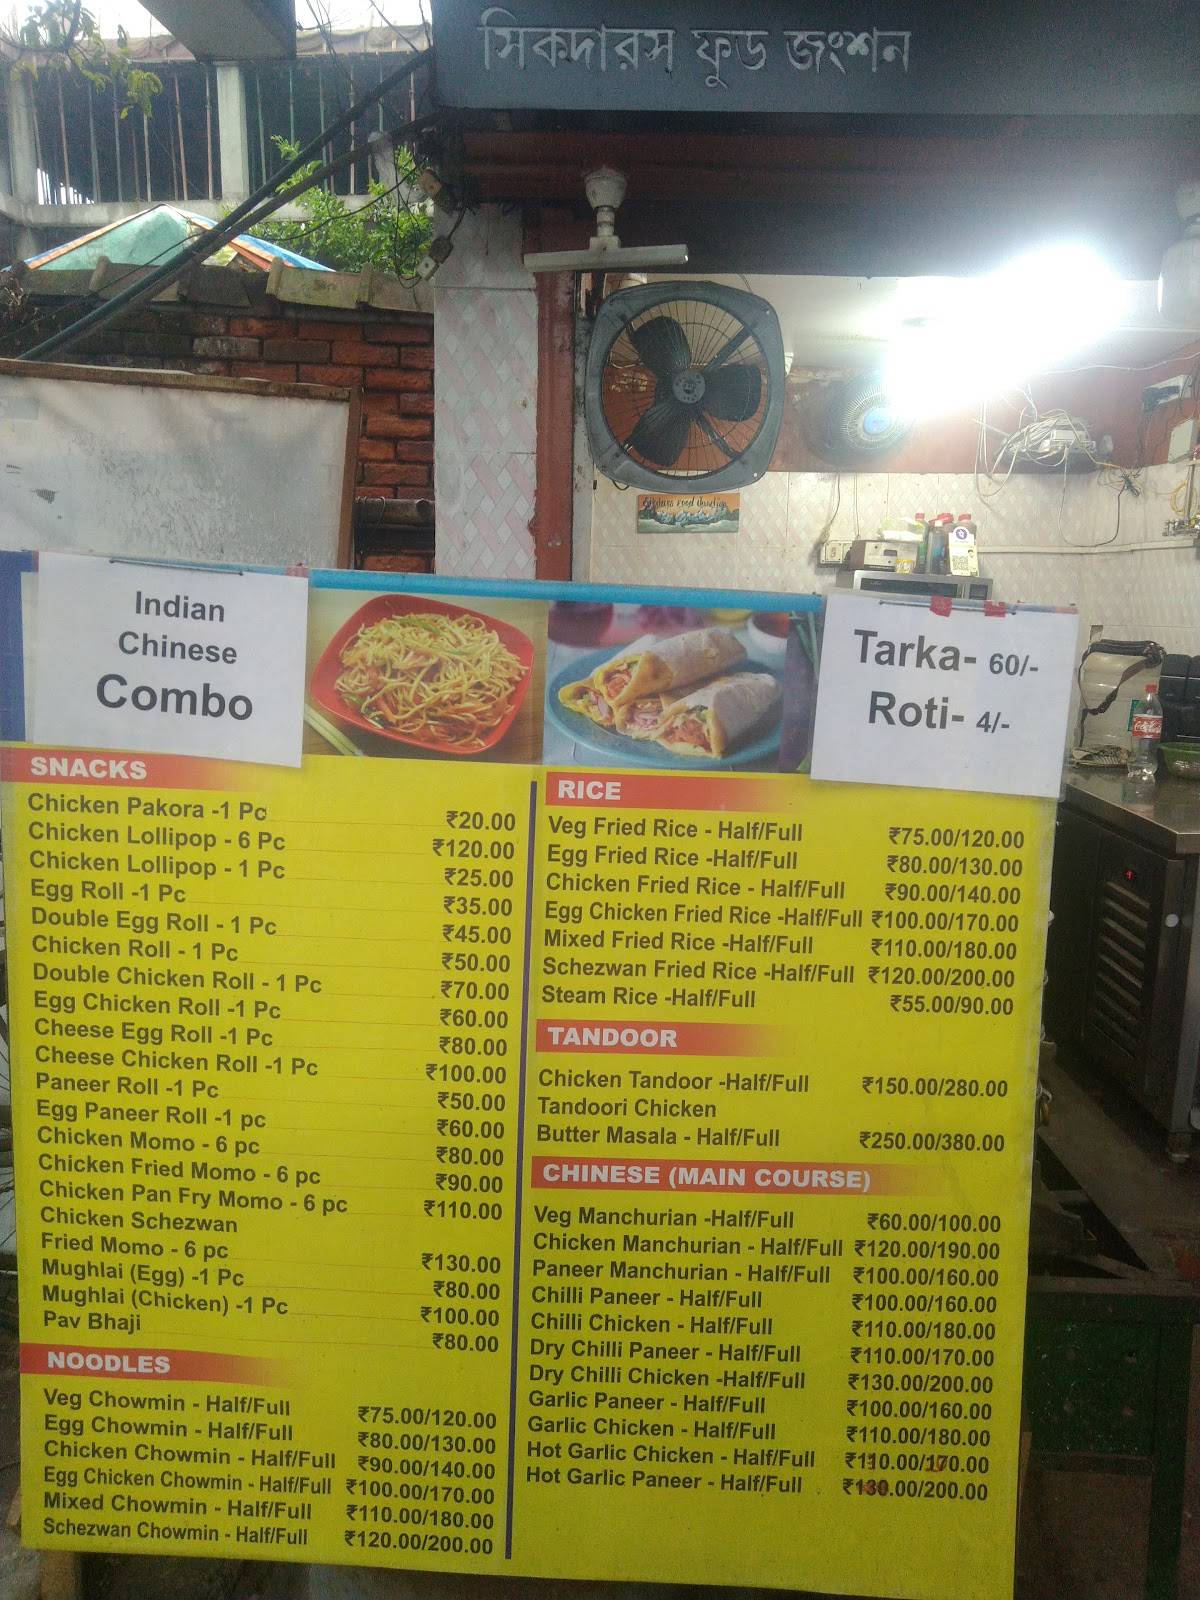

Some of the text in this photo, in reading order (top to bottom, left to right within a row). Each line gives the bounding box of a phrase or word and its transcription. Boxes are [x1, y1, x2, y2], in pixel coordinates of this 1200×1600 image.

[477, 7, 912, 90] সিকদারস ফুড জংশন
[135, 591, 225, 622] Indian
[118, 631, 237, 665] Chinese
[854, 629, 1038, 676] Tarka- 60/-
[96, 673, 253, 721] Combo
[869, 690, 1010, 734] Roti- 4/-
[30, 756, 149, 780] SNACKS
[558, 779, 622, 801] RICE
[28, 792, 119, 815] Chicken
[127, 796, 204, 818] Pakora
[239, 802, 267, 821] Pc
[446, 810, 516, 832] ₹20.00
[547, 843, 588, 868] Egg
[595, 845, 647, 865] Fried
[654, 847, 699, 867] Rice
[886, 854, 1023, 877] ₹80.00/130.00
[31, 878, 73, 903] Egg
[81, 880, 124, 900] Roll
[158, 884, 186, 903] Pc
[443, 895, 513, 917] ₹35.00
[545, 900, 583, 924] Egg
[589, 901, 668, 922] Chicken
[674, 904, 723, 923] Fried
[729, 905, 771, 925] Rice
[871, 910, 1019, 933] ₹100.00/170.00
[544, 928, 605, 948] Mixed
[612, 930, 664, 950] Fried
[671, 932, 716, 951] Rice
[871, 938, 1017, 961] ₹110.00/180.00
[542, 956, 647, 977] Schezwan
[654, 959, 706, 979] Fried
[712, 961, 757, 980] Rice
[868, 966, 1015, 988] ₹120.00/200.00
[34, 990, 76, 1014] Egg
[83, 992, 170, 1014] Chicken
[178, 997, 220, 1016] Roll
[254, 1000, 281, 1019] Pc
[439, 1008, 509, 1029] ₹60.00
[541, 984, 606, 1004] Steam
[613, 986, 658, 1006] Rice
[890, 994, 1014, 1016] ₹55.00/90.00
[34, 1017, 114, 1039] Cheese
[121, 1021, 163, 1046] Egg
[171, 1024, 212, 1044] Roll
[246, 1028, 273, 1047] Pc
[439, 1036, 508, 1057] ₹80.00
[547, 1026, 678, 1048] TANDOOR
[35, 1045, 115, 1066] Cheese
[121, 1049, 208, 1071] Chicken
[216, 1053, 258, 1073] Roll
[291, 1057, 318, 1076] Pc
[425, 1063, 507, 1084] ₹100.00
[36, 1071, 111, 1093] Paneer
[117, 1076, 158, 1096] Roll
[192, 1079, 219, 1099] Pc
[437, 1091, 506, 1112] ₹50.00
[538, 1068, 622, 1088] Chicken
[628, 1070, 713, 1090] Tandoor
[862, 1076, 1008, 1098] ₹150.00/280.00
[36, 1099, 78, 1123] Egg
[85, 1101, 160, 1122] Paneer
[166, 1105, 207, 1125] Roll
[241, 1114, 266, 1131] pc
[436, 1118, 505, 1140] ₹60.00
[537, 1096, 717, 1118] Tandoori Chicken
[537, 1123, 601, 1143] Butter
[606, 1125, 677, 1145] Masala
[697, 1127, 780, 1147] Half/Full
[859, 1131, 1005, 1152] ₹250.00/380.00
[543, 1163, 871, 1193] CHINESE (MAIN COURSE)
[40, 1206, 238, 1233] Chicken Schezwan
[533, 1205, 572, 1228] Veg
[578, 1206, 697, 1227] Manchurian
[867, 1212, 1001, 1233] ₹60.00/100.00
[41, 1231, 94, 1252] Fried
[100, 1235, 164, 1257] Momo
[184, 1240, 197, 1258] 6
[203, 1245, 229, 1263] pc
[421, 1252, 501, 1274] ₹130.00
[42, 1258, 123, 1281] Mughlai
[130, 1263, 185, 1288] (Egg)
[218, 1268, 244, 1287] Pc
[433, 1280, 501, 1301] ₹80.00
[42, 1284, 124, 1308] Mughlai
[131, 1289, 229, 1317] (Chicken)
[262, 1296, 288, 1315] Pc
[420, 1306, 500, 1327] ₹100.00
[531, 1285, 583, 1304] Chilli
[590, 1287, 661, 1306] Paneer
[679, 1289, 762, 1308] Half/Full
[851, 1293, 997, 1314] ₹100.00/160.00
[43, 1310, 499, 1353] Pav Bhaji ₹80.00
[46, 1351, 171, 1374] NOODLES
[529, 1364, 565, 1386] Dry
[570, 1365, 622, 1384] Chilli
[628, 1367, 709, 1387] Chicken
[847, 1373, 994, 1394] ₹130.00/200.00
[43, 1388, 82, 1411] Veg
[88, 1389, 185, 1412] Chowmin
[206, 1394, 290, 1417] Half/Full
[357, 1405, 497, 1430] ₹75.00/120.00
[527, 1415, 587, 1434] Garlic
[593, 1417, 674, 1437] Chicken
[694, 1420, 776, 1440] Half/Full
[846, 1425, 991, 1447] ₹110.00/180.00
[44, 1439, 128, 1460] Chicken
[134, 1443, 231, 1465] Chowmin
[251, 1449, 336, 1469] Half/Full
[357, 1455, 496, 1480] ₹90.00/140.00
[43, 1517, 131, 1538] Schezwan
[136, 1521, 219, 1542] Chowmin
[236, 1525, 308, 1545] Half/Full
[344, 1529, 493, 1555] ₹120.00/200.00
